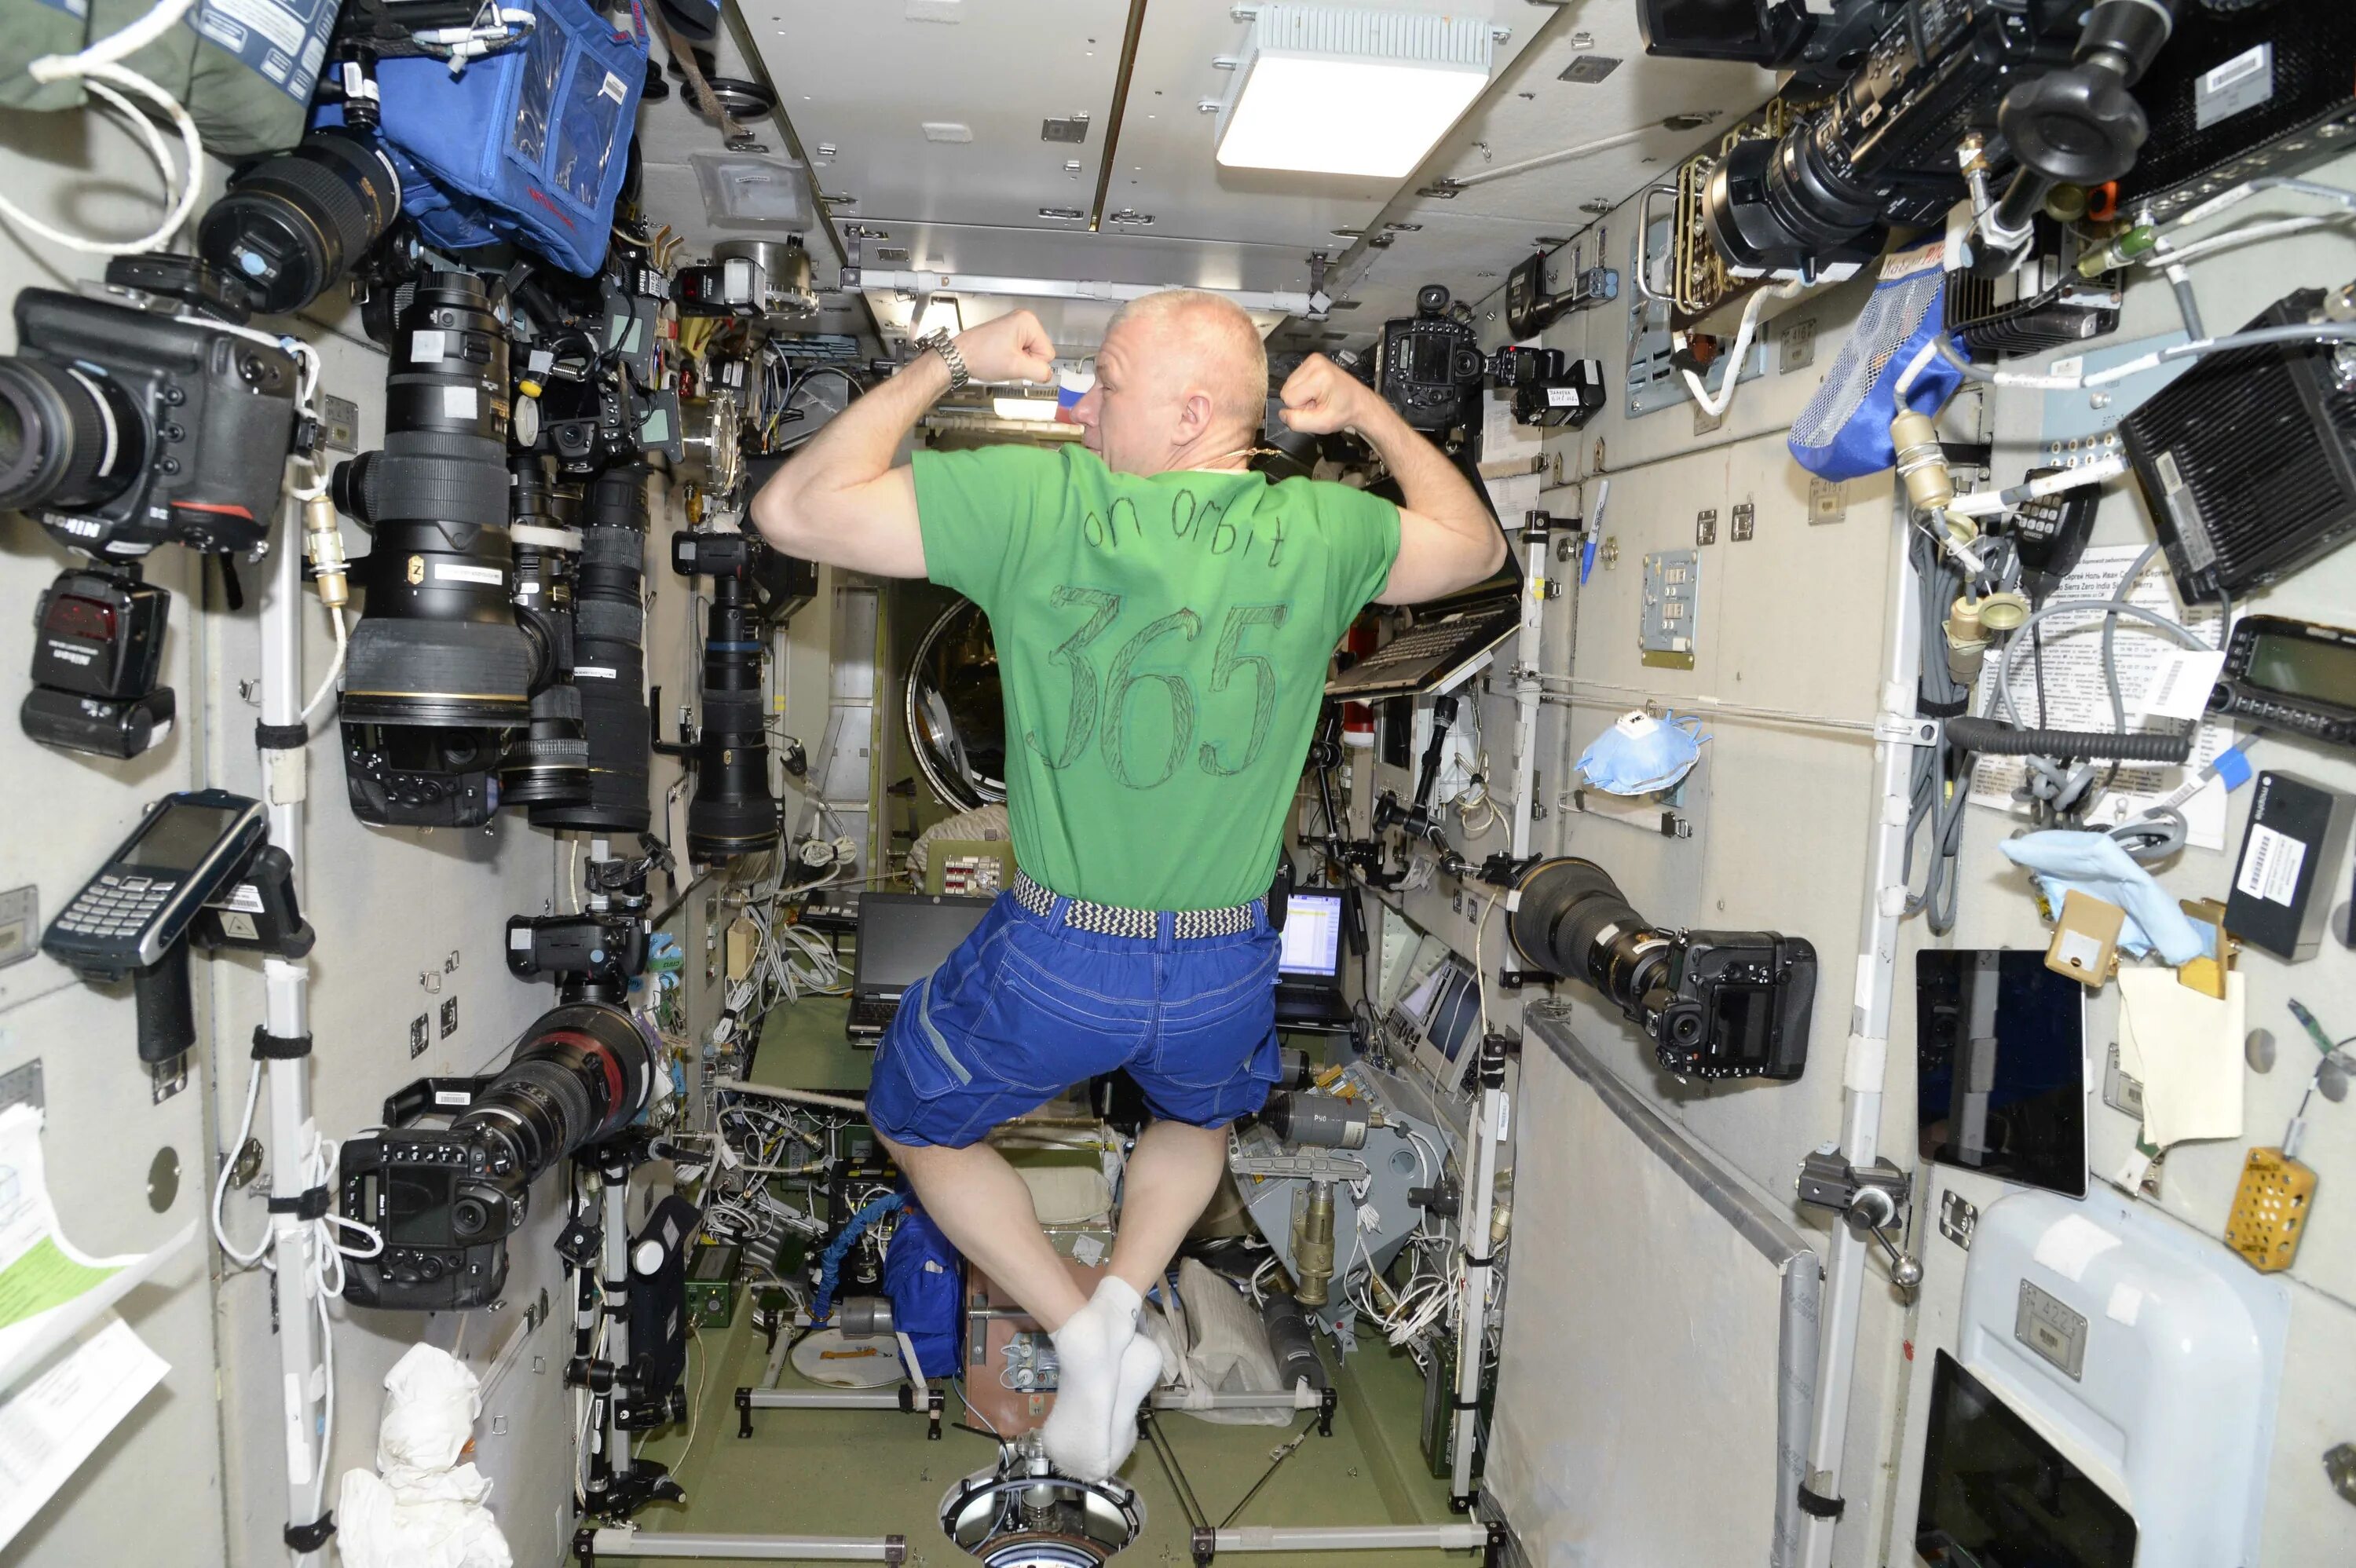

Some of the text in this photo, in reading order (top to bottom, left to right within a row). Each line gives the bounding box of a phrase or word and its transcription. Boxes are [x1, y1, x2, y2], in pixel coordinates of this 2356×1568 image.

[42, 511, 101, 539] Nikon
[1084, 488, 1143, 548] on
[1595, 502, 1605, 528] Sharpie
[2023, 530, 2043, 540] KENWOOD
[53, 649, 91, 666] Nikon
[1028, 584, 1289, 791] 365
[1630, 715, 1644, 723] 3M
[2254, 786, 2269, 821] mophie
